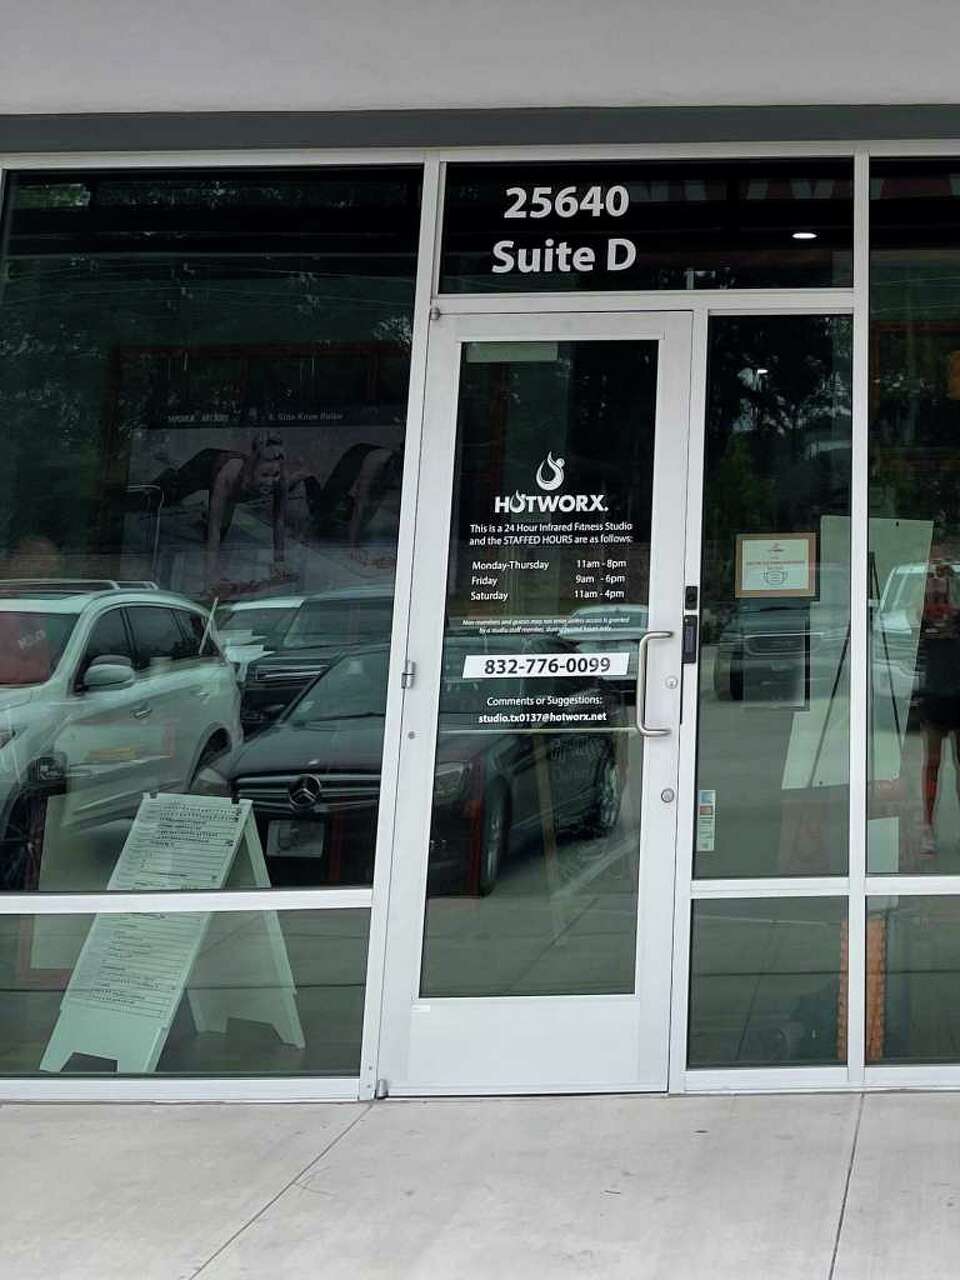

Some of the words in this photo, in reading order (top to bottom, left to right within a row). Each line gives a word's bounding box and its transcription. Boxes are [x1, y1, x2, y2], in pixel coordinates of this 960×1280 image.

[504, 185, 630, 218] 25640
[492, 238, 596, 273] Suite
[607, 238, 637, 271] D
[470, 524, 488, 534] This
[489, 524, 496, 533] is
[504, 523, 515, 533] 24
[516, 523, 538, 533] Hour
[539, 522, 573, 533] Infrared
[574, 522, 604, 532] Fitness
[605, 521, 633, 531] Studio
[469, 536, 486, 546] and
[487, 536, 502, 545] the
[503, 535, 541, 545] STAFFED
[542, 534, 573, 544] HOURS
[574, 536, 588, 544] are
[589, 536, 599, 544] as
[600, 533, 633, 544] follows:
[472, 560, 550, 572] Monday-Thursday
[577, 559, 600, 568] 11am
[606, 559, 627, 569] 8pm
[471, 576, 498, 587] Friday
[575, 575, 595, 583] 9am
[606, 574, 626, 585] 6pm
[471, 591, 509, 602] Saturday
[574, 589, 598, 598] 11am
[605, 589, 625, 600] 4pm
[484, 657, 611, 675] 832-776-0099
[486, 696, 535, 707] Comments
[536, 697, 545, 705] or
[547, 695, 603, 708] Suggestions:
[478, 711, 608, 724] studio.tx0137@hotworx.net
